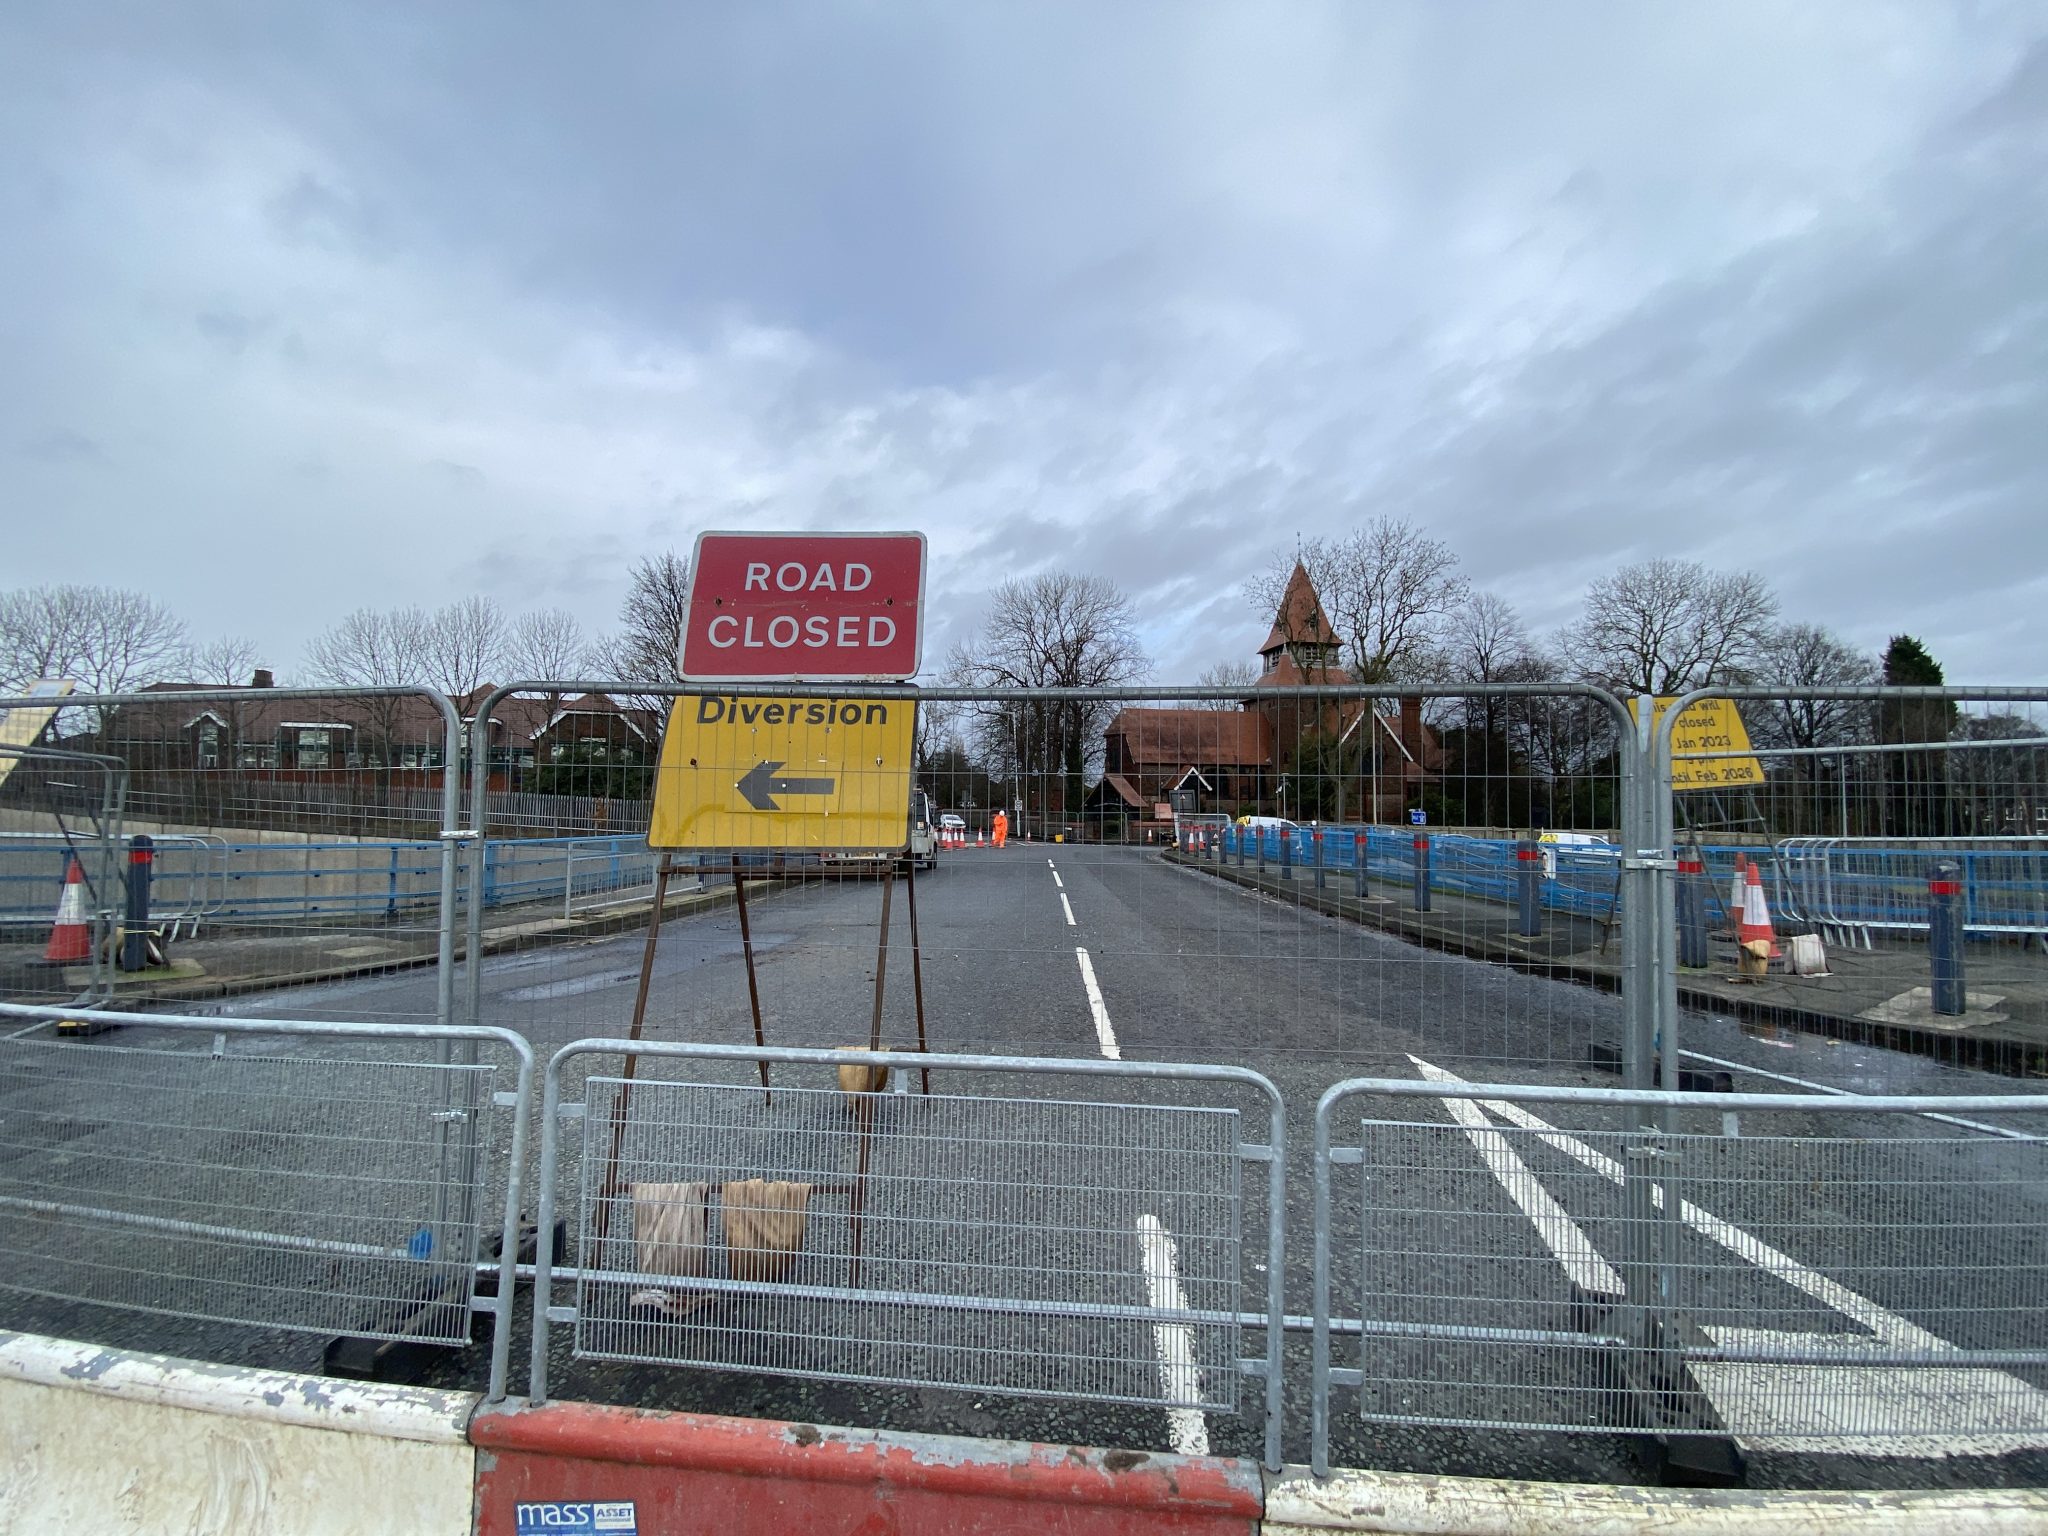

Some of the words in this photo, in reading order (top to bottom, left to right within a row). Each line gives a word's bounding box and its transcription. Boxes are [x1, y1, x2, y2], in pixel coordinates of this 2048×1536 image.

[744, 562, 873, 592] ROAD
[707, 616, 898, 648] CLOSED
[696, 696, 889, 726] Diversion
[1699, 700, 1720, 710] will
[1679, 716, 1715, 727] closed
[1677, 738, 1696, 748] Jan
[1699, 736, 1731, 747] 2023
[1671, 773, 1690, 783] ntil
[1696, 770, 1717, 780] Feb
[1722, 767, 1753, 779] 2026
[517, 1504, 591, 1526] mass
[596, 1508, 632, 1517] ASSET
